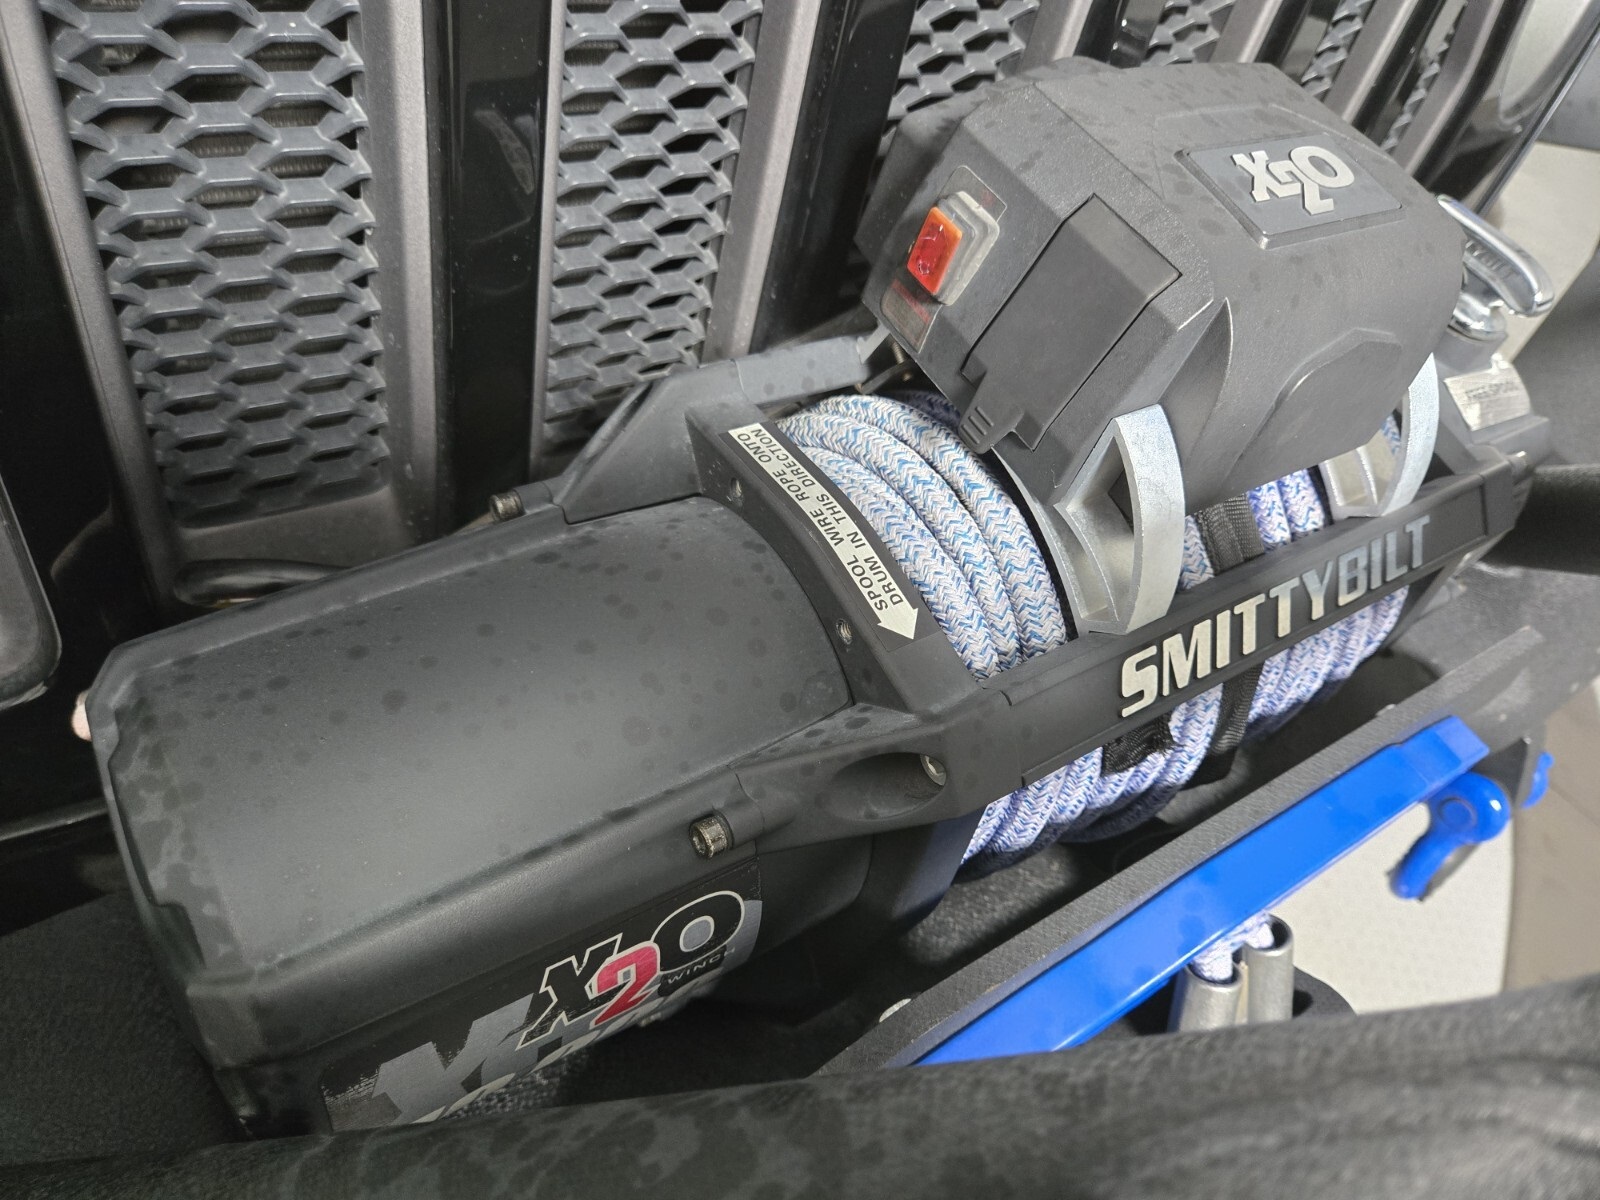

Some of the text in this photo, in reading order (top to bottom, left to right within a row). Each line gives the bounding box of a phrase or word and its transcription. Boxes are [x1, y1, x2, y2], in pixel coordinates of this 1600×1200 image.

[737, 432, 889, 611] SPOOL WIRE ROPE ONTO
[751, 428, 904, 606] DRUM IN THIS DIRECTION
[1121, 515, 1430, 717] SMITTYBILT
